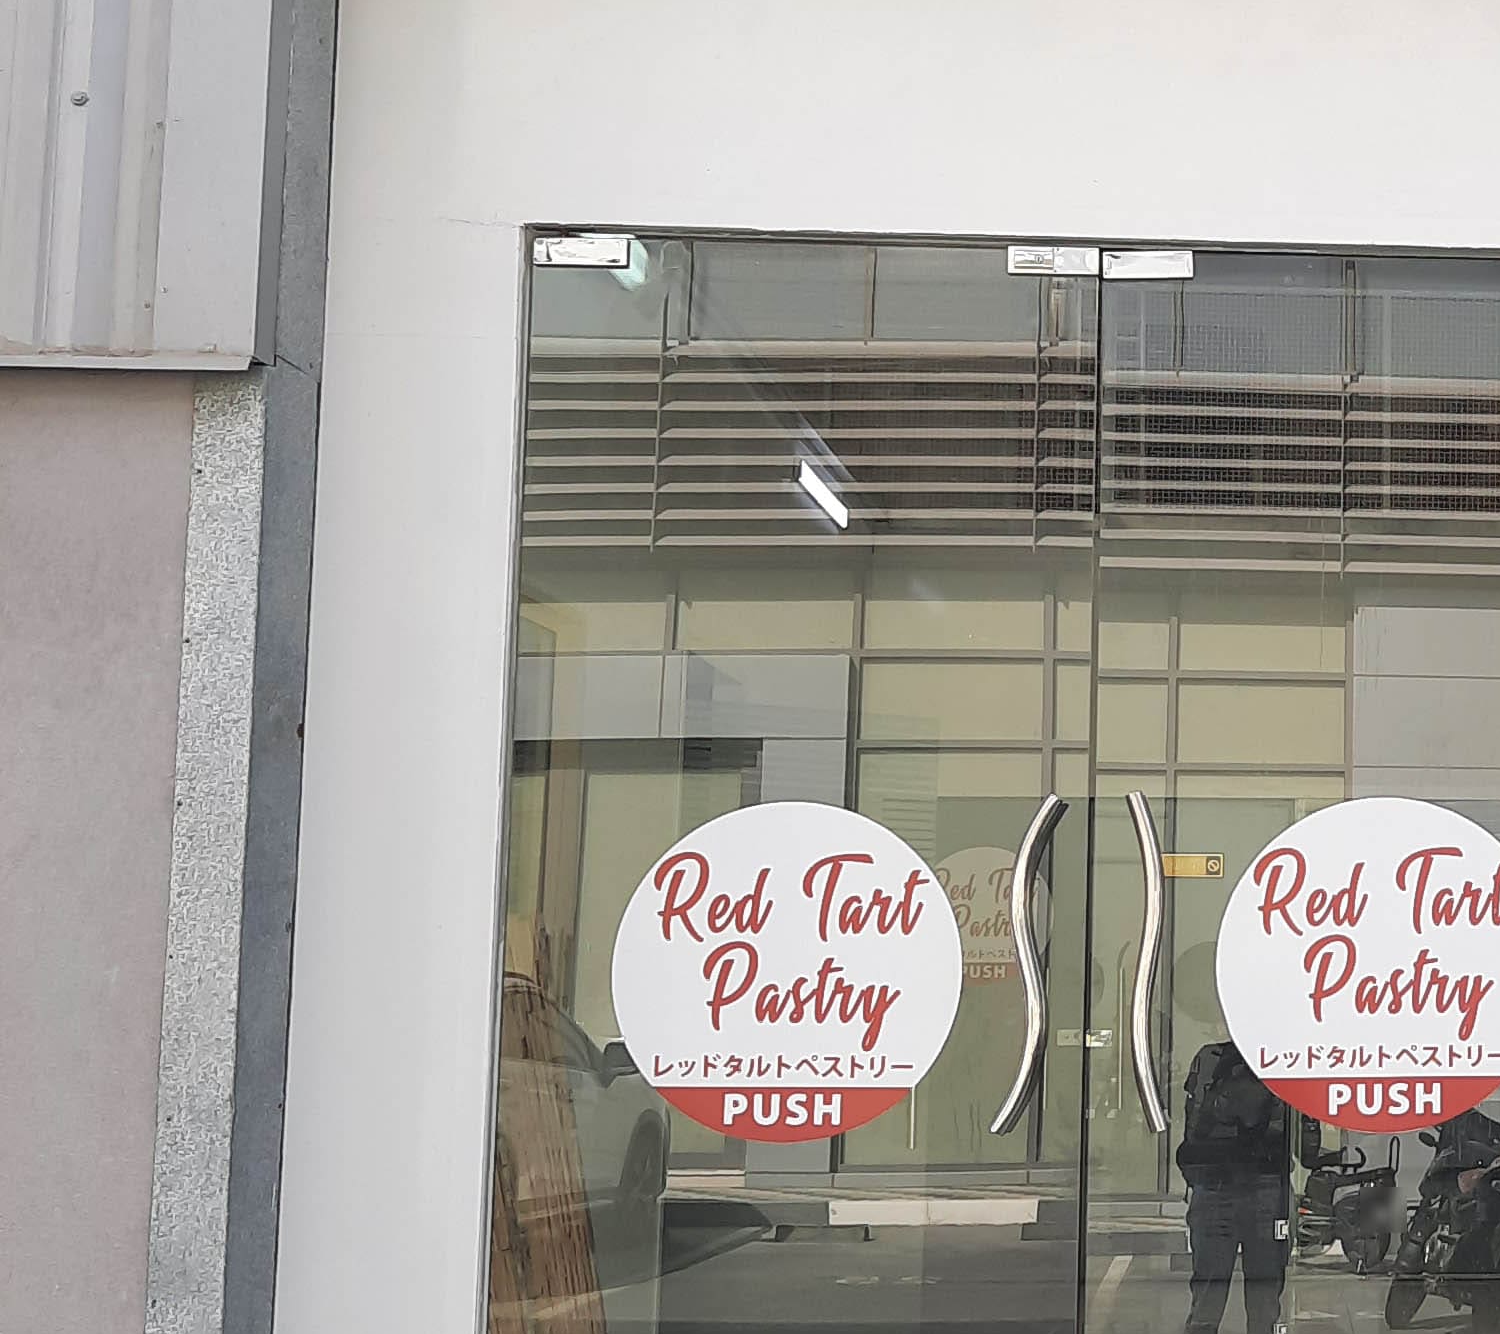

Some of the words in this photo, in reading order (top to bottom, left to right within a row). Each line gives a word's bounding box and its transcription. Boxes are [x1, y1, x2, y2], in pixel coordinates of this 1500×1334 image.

[654, 852, 773, 942] Red
[802, 853, 930, 943] Tart
[1253, 847, 1368, 936] Red
[703, 941, 900, 1052] Pastry
[1304, 934, 1494, 1041] Pastry
[654, 1054, 914, 1079] レッドタルトペストリー
[723, 1093, 842, 1126] PUSH
[1328, 1082, 1442, 1116] PUSH
